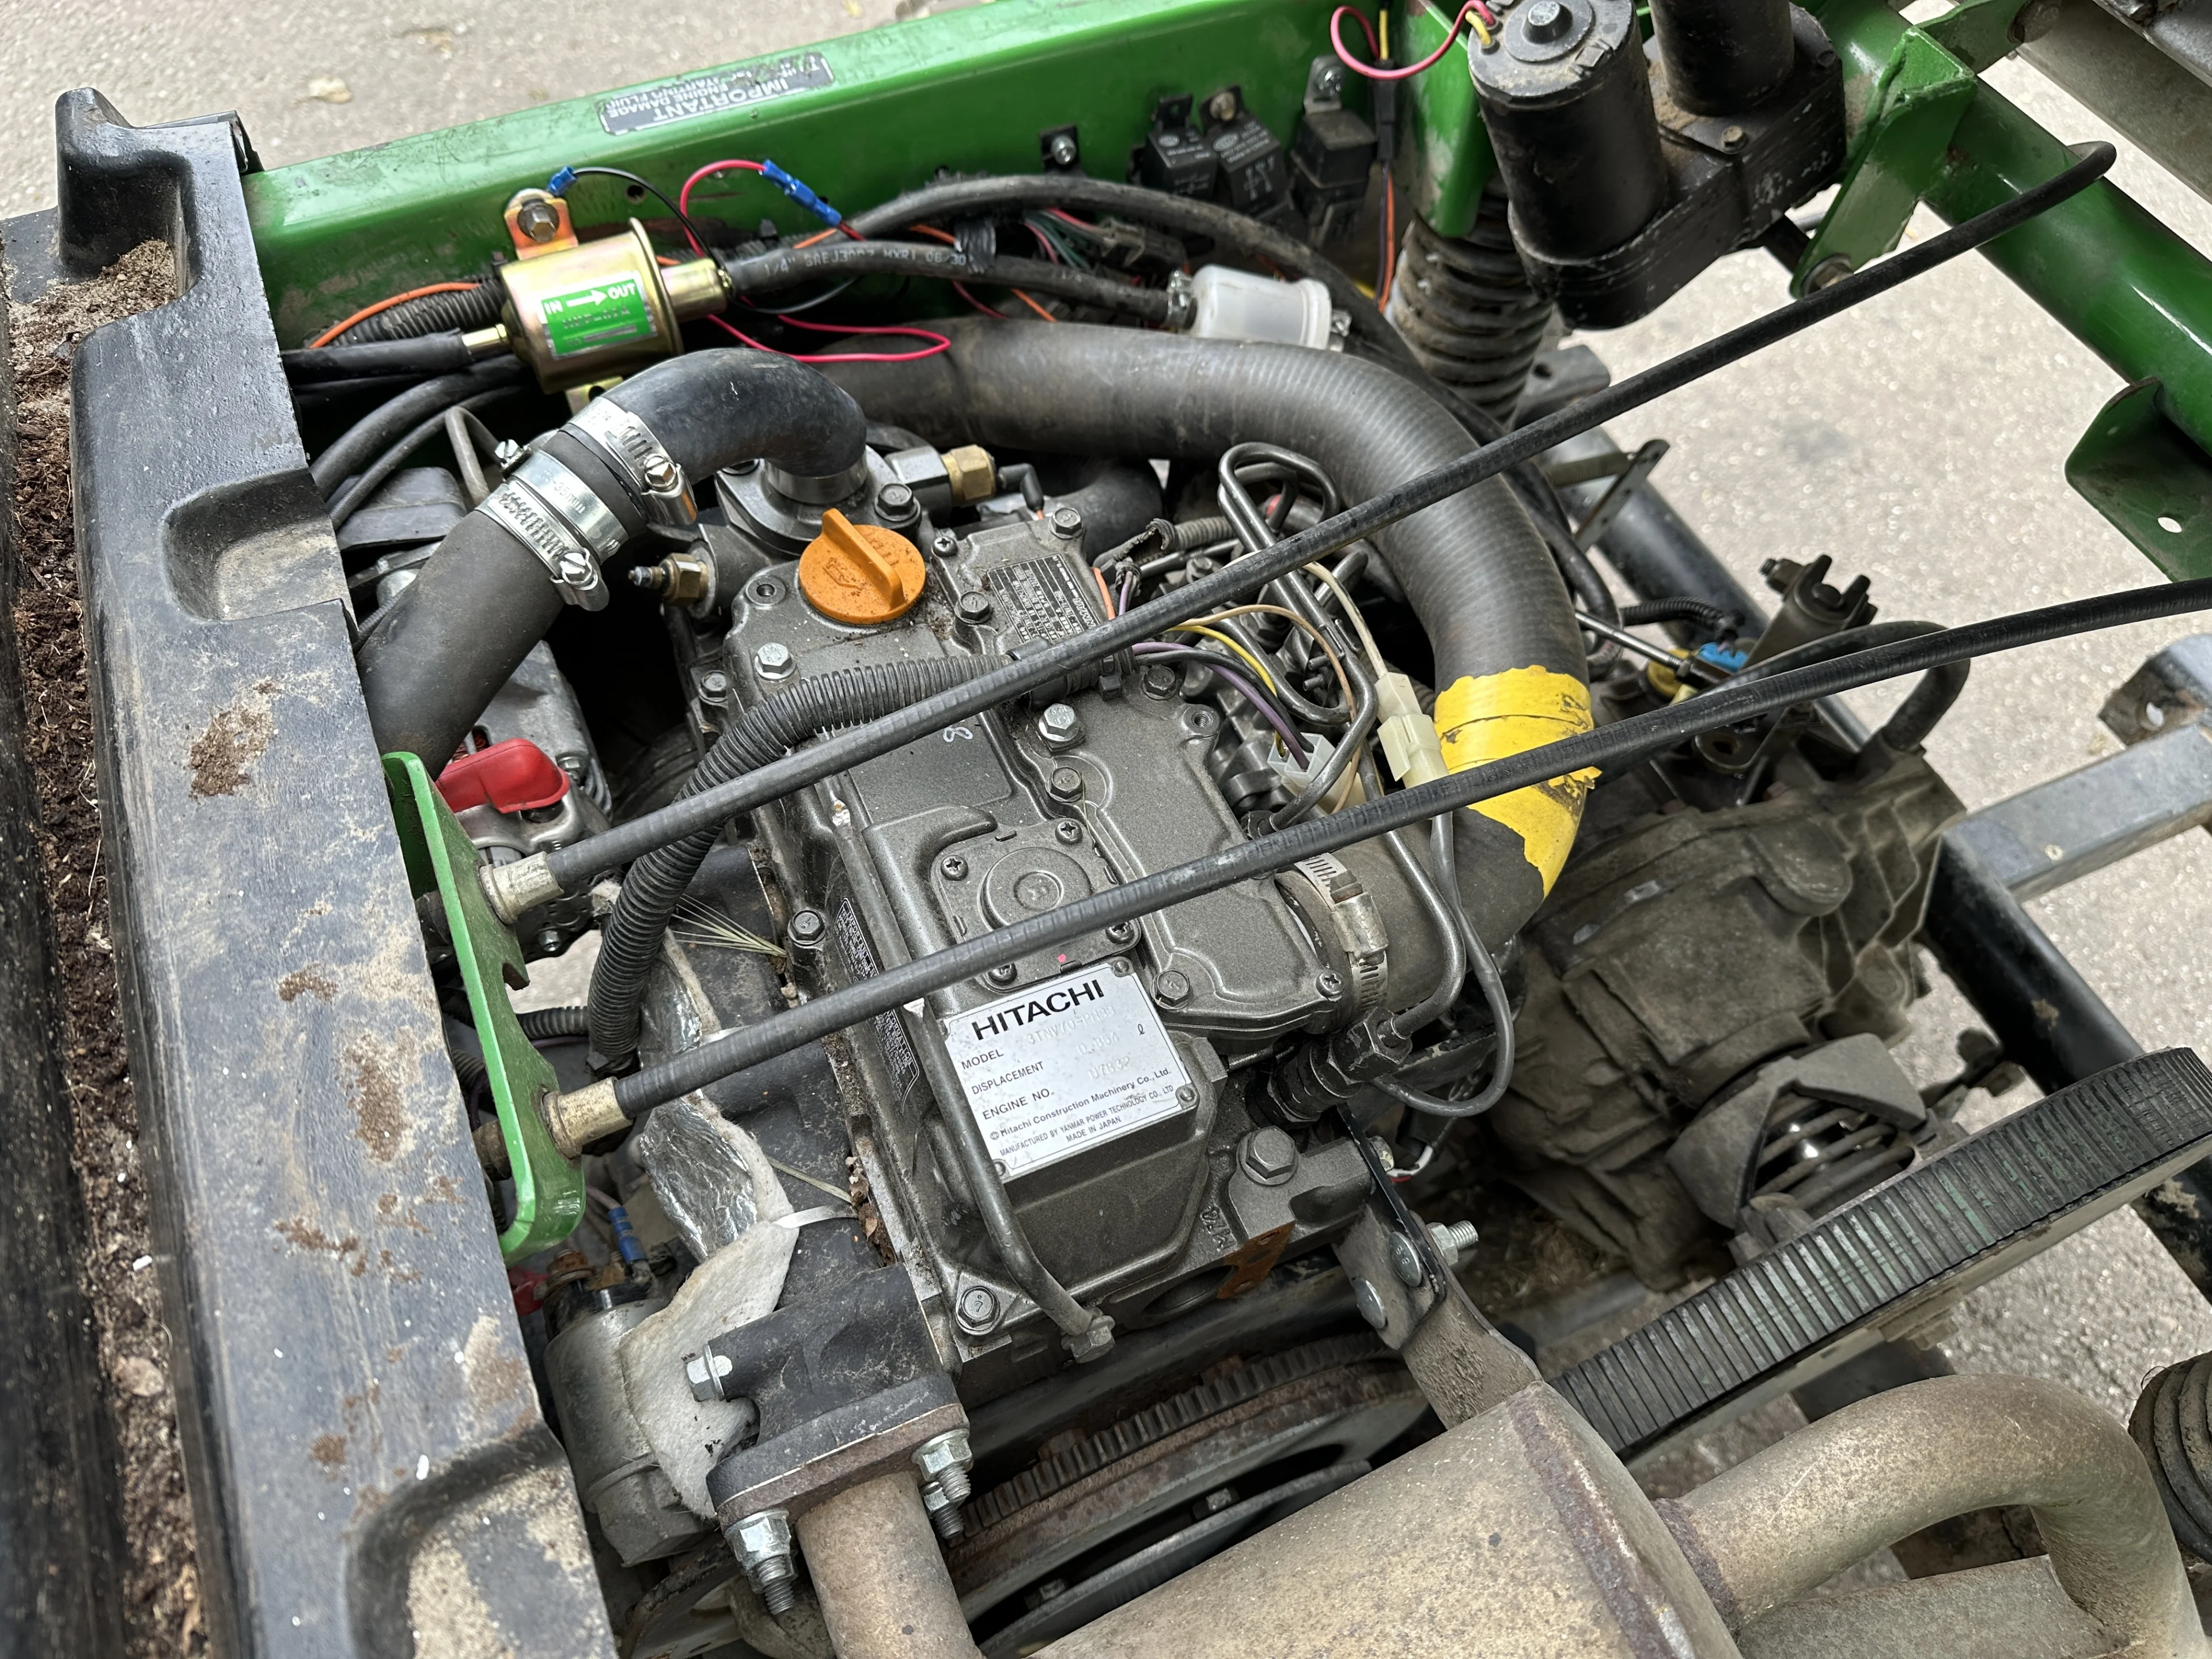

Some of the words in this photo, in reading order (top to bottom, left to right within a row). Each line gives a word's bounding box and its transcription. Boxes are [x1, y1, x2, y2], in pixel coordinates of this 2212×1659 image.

[607, 96, 671, 118] DAMAGE
[653, 78, 789, 122] IMPORTANT
[543, 299, 563, 315] IN
[607, 282, 635, 300] OUT
[1071, 596, 1097, 630] NMAR
[971, 979, 1105, 1040] HITACHI
[961, 1049, 1004, 1070] MODEL
[972, 1061, 1044, 1094] DISPLACEMENT
[982, 1097, 1028, 1120] ENGINE
[1032, 1089, 1054, 1101] NO.
[1000, 1119, 1032, 1137] Hitachi
[1033, 1099, 1089, 1124] Construction
[1091, 1082, 1135, 1102] Machinery
[1000, 1132, 1048, 1156] MANUFACTURED
[1050, 1128, 1059, 1138] BY
[1060, 1119, 1085, 1132] YANMAR
[1086, 1110, 1108, 1123] POWER
[1108, 1094, 1147, 1114] TECHNOLOGY
[1066, 1129, 1087, 1142] MADE
[1099, 1116, 1122, 1130] JAPAN
